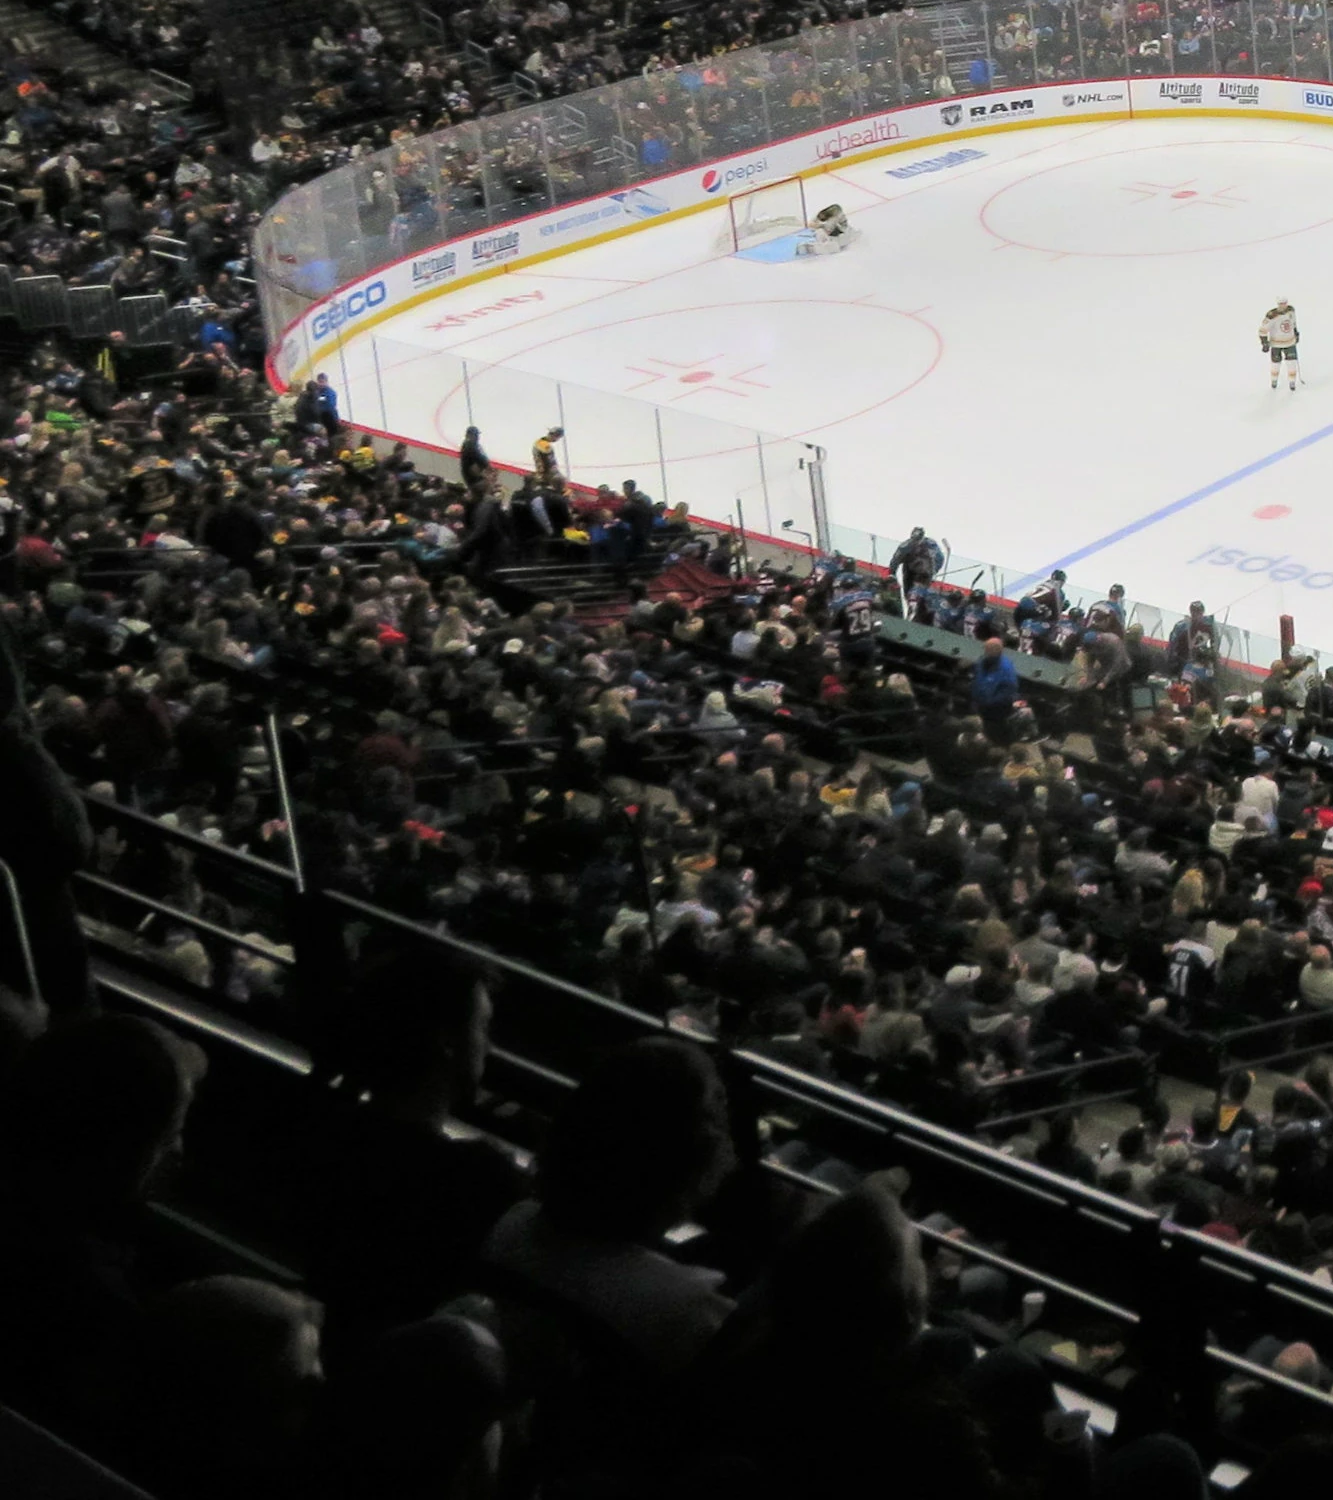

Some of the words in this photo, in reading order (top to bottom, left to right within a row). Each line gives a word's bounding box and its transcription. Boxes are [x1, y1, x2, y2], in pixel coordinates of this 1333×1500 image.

[1078, 94, 1123, 104] NHL.COM
[1160, 83, 1202, 97] Altitude
[1219, 82, 1260, 97] Altitude
[970, 99, 1034, 117] RAM
[815, 117, 900, 160] uchealth
[723, 159, 768, 187] pepsi
[471, 231, 520, 257] Altitude
[412, 252, 457, 279] Altitude
[312, 280, 387, 341] GEICO
